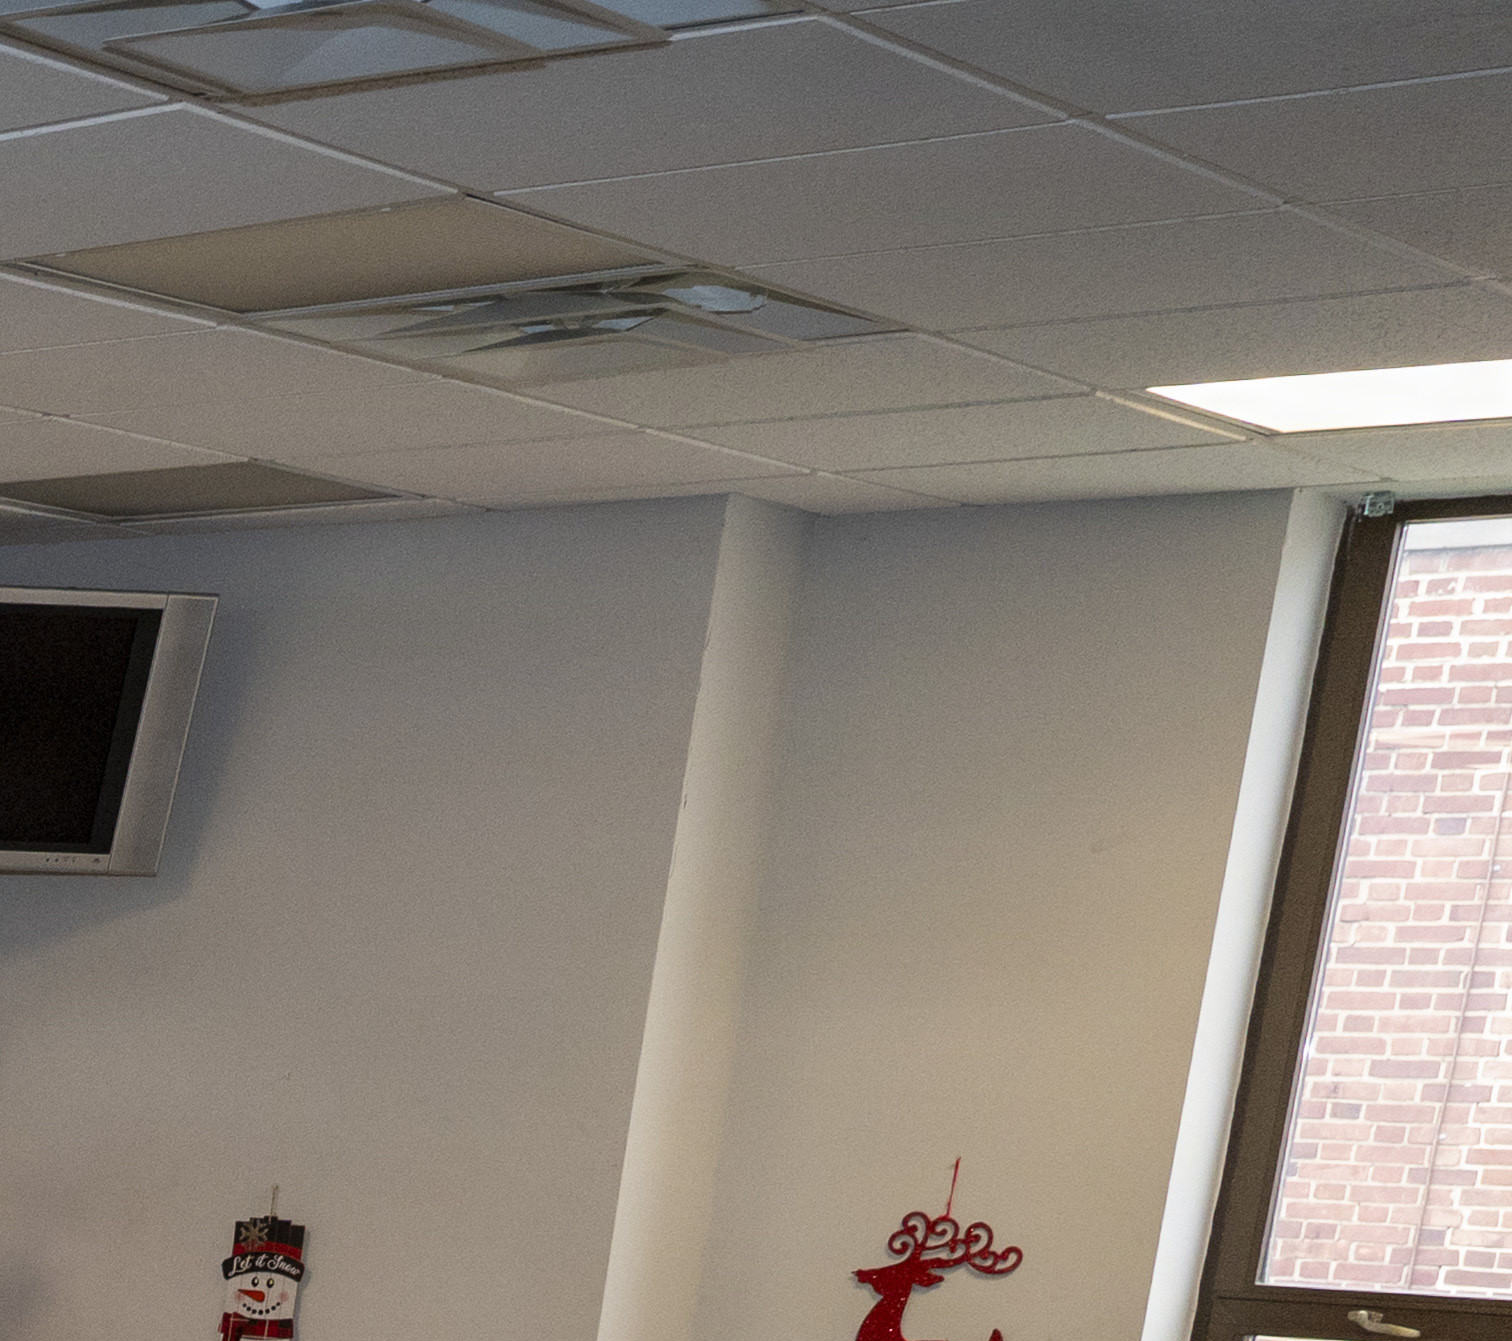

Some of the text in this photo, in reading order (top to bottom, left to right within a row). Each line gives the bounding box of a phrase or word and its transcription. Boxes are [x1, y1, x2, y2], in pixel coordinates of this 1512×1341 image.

[228, 1254, 301, 1277] Let it Snow
